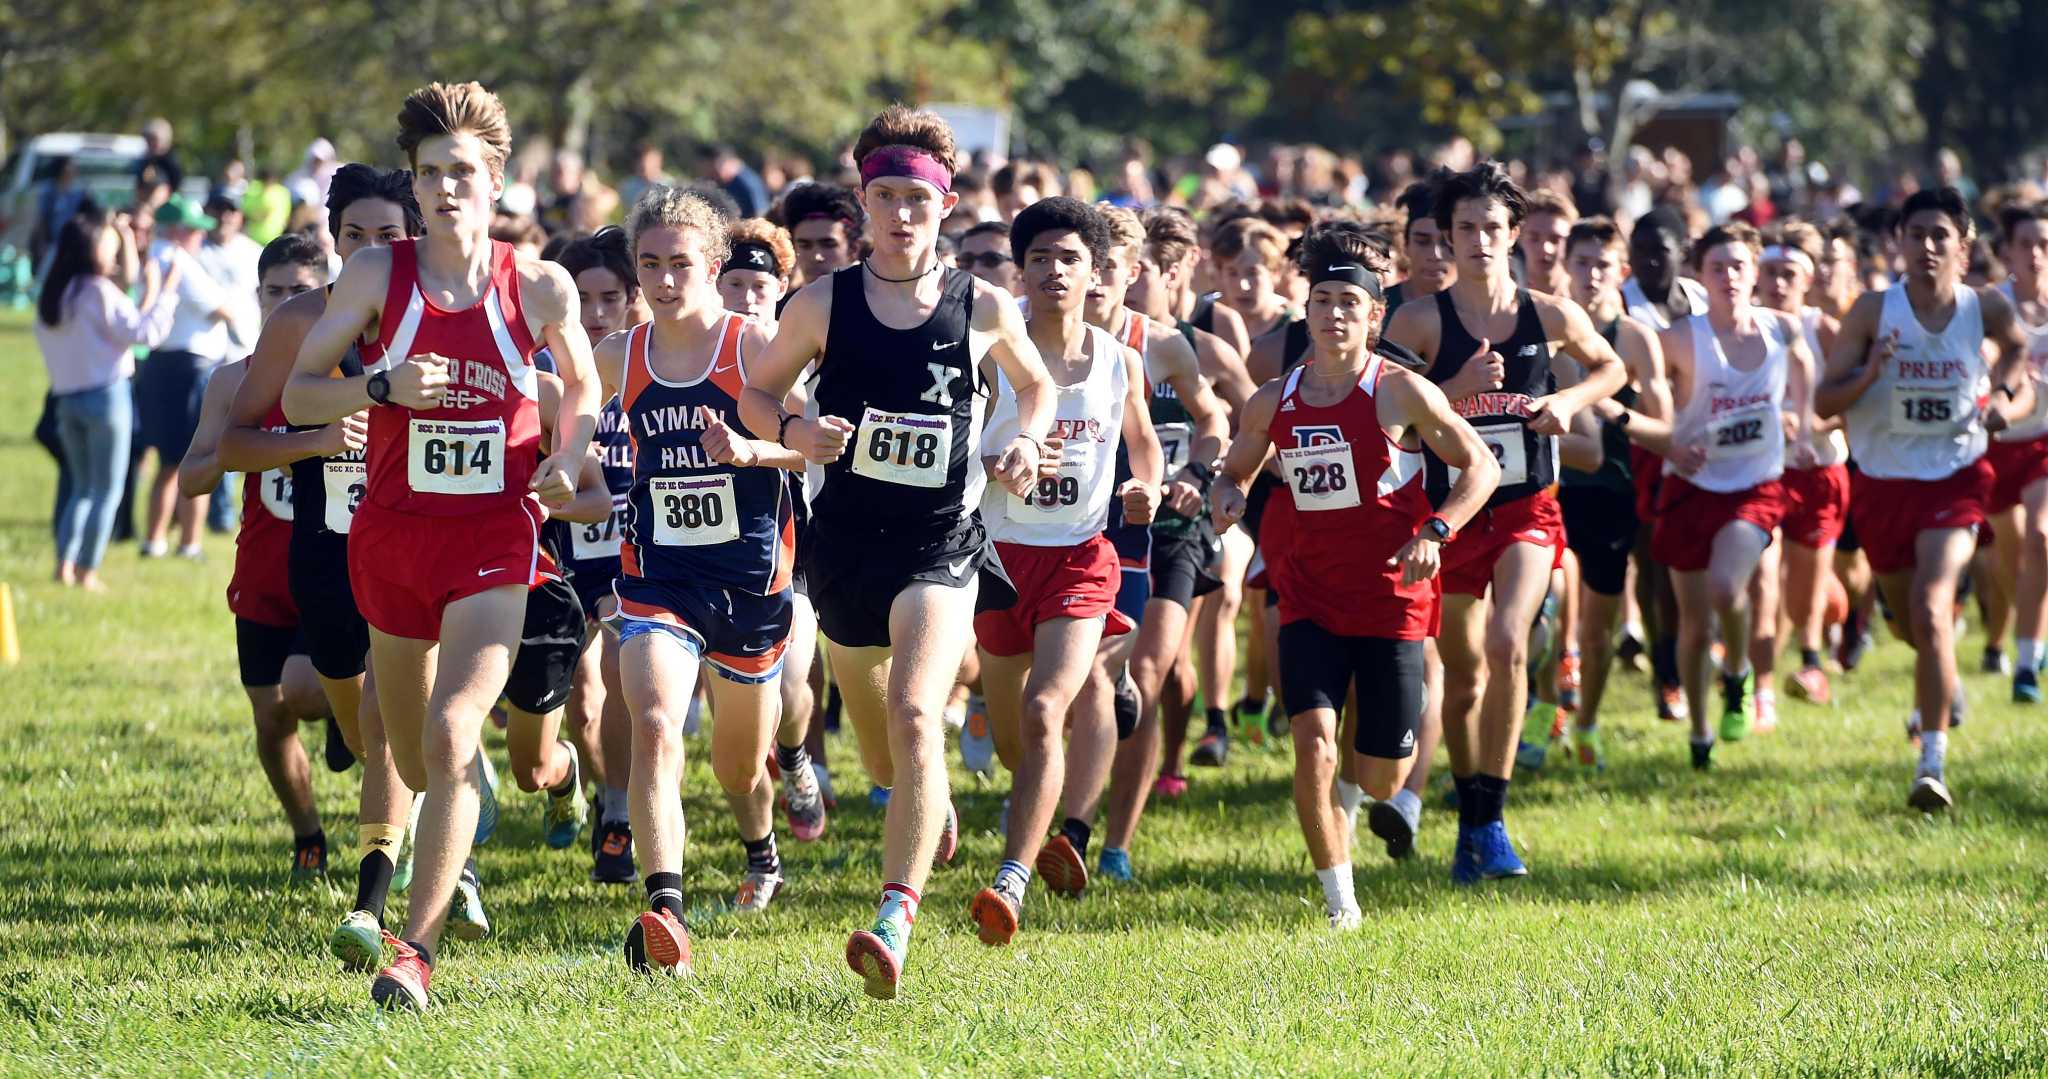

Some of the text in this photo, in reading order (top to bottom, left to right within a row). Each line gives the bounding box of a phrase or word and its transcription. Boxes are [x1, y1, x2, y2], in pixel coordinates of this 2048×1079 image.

[749, 250, 764, 265] X
[464, 360, 507, 401] CROSS
[920, 362, 961, 407] X
[869, 413, 947, 430] SCC XC Championship
[1902, 397, 1951, 424] 185
[417, 424, 500, 436] SCC XC Championship
[1717, 419, 1763, 447] 202
[424, 438, 492, 476] 614
[868, 427, 939, 469] 618
[1163, 440, 1179, 469] 7
[344, 465, 354, 473] XC
[1293, 462, 1347, 494] 228
[663, 492, 723, 529] 380
